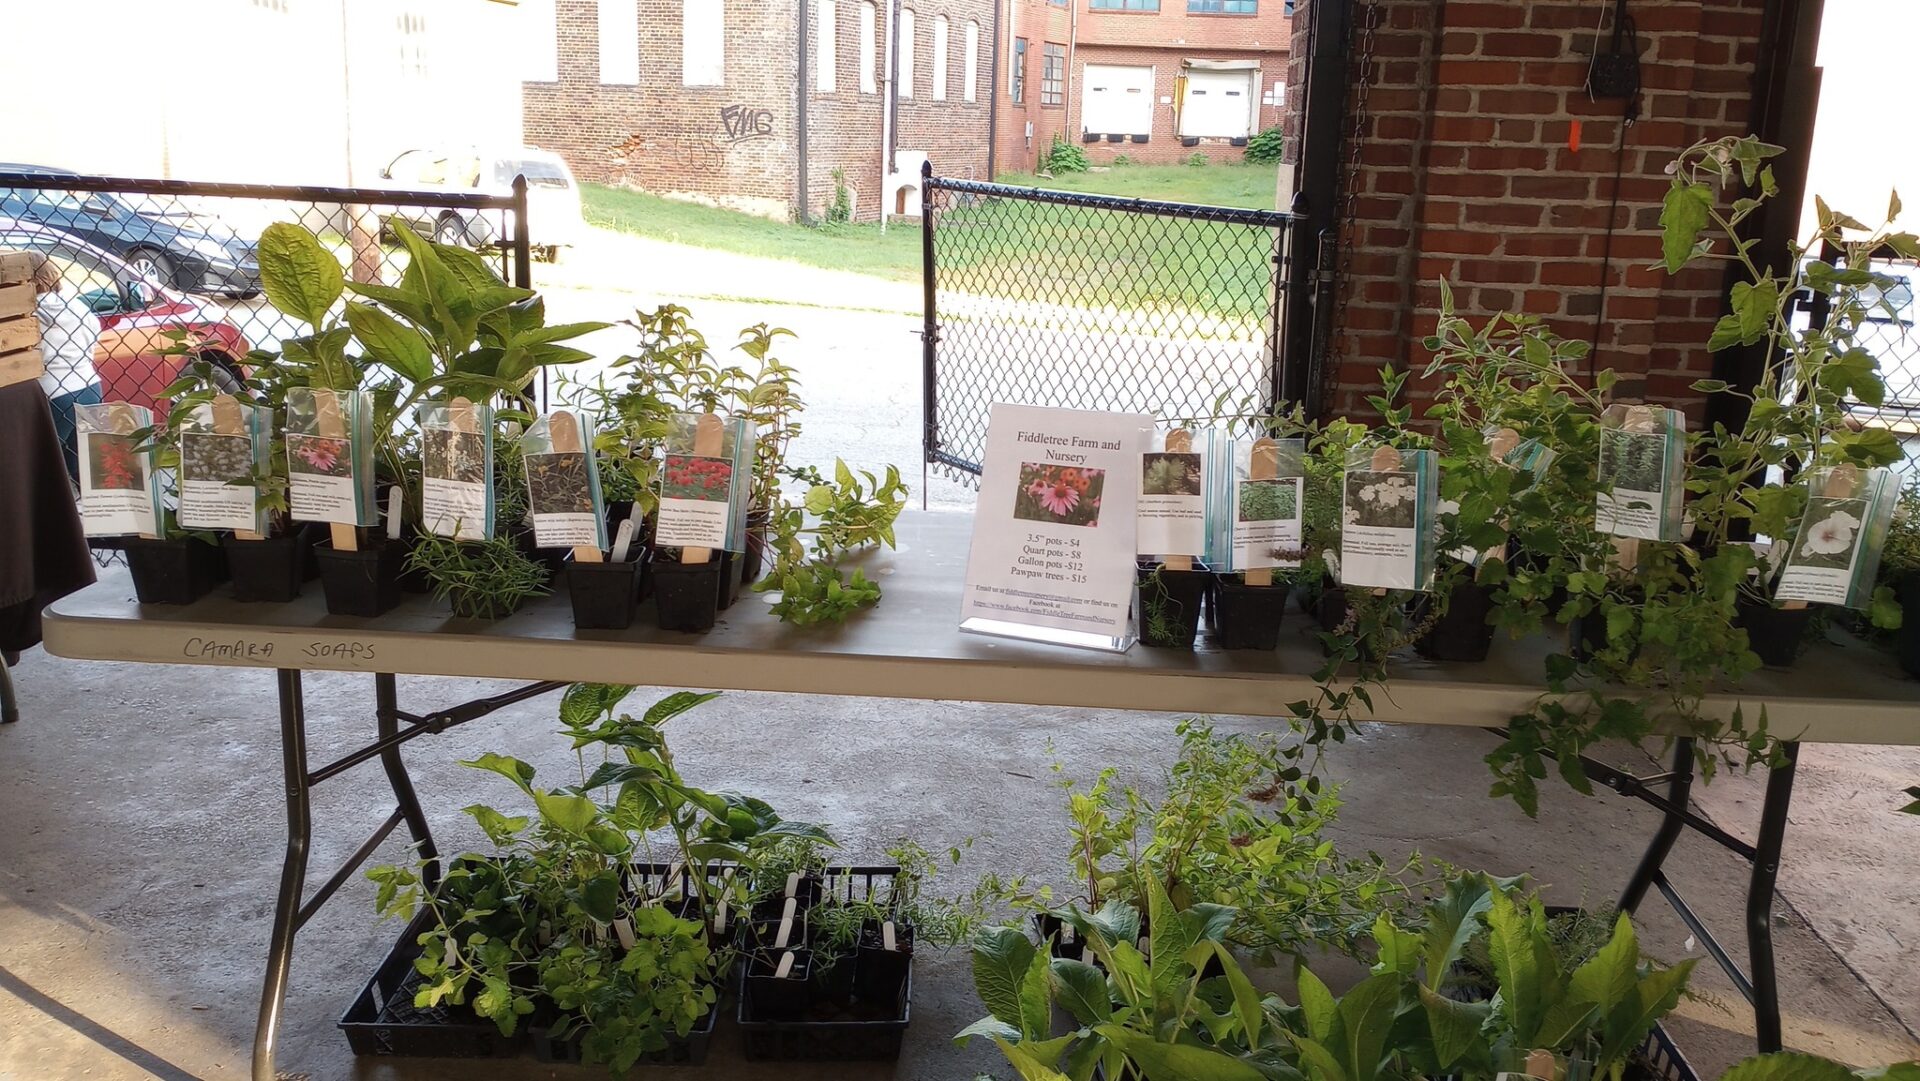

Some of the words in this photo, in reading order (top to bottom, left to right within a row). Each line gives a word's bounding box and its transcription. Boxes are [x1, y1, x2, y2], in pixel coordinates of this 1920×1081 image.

[1017, 431, 1068, 446] Fiddletree
[1071, 436, 1098, 449] Farm
[1101, 440, 1121, 450] and
[1046, 449, 1087, 465] Nursery
[1045, 538, 1062, 546] pots
[1023, 545, 1045, 555] Quart
[1047, 549, 1063, 558] pots
[1018, 556, 1044, 567] Gallon
[1045, 561, 1062, 569] pots
[1010, 566, 1043, 579] Pawpaw
[1045, 572, 1064, 581] trees
[1029, 599, 1054, 608] Facebook
[302, 642, 376, 659] SOAPS
